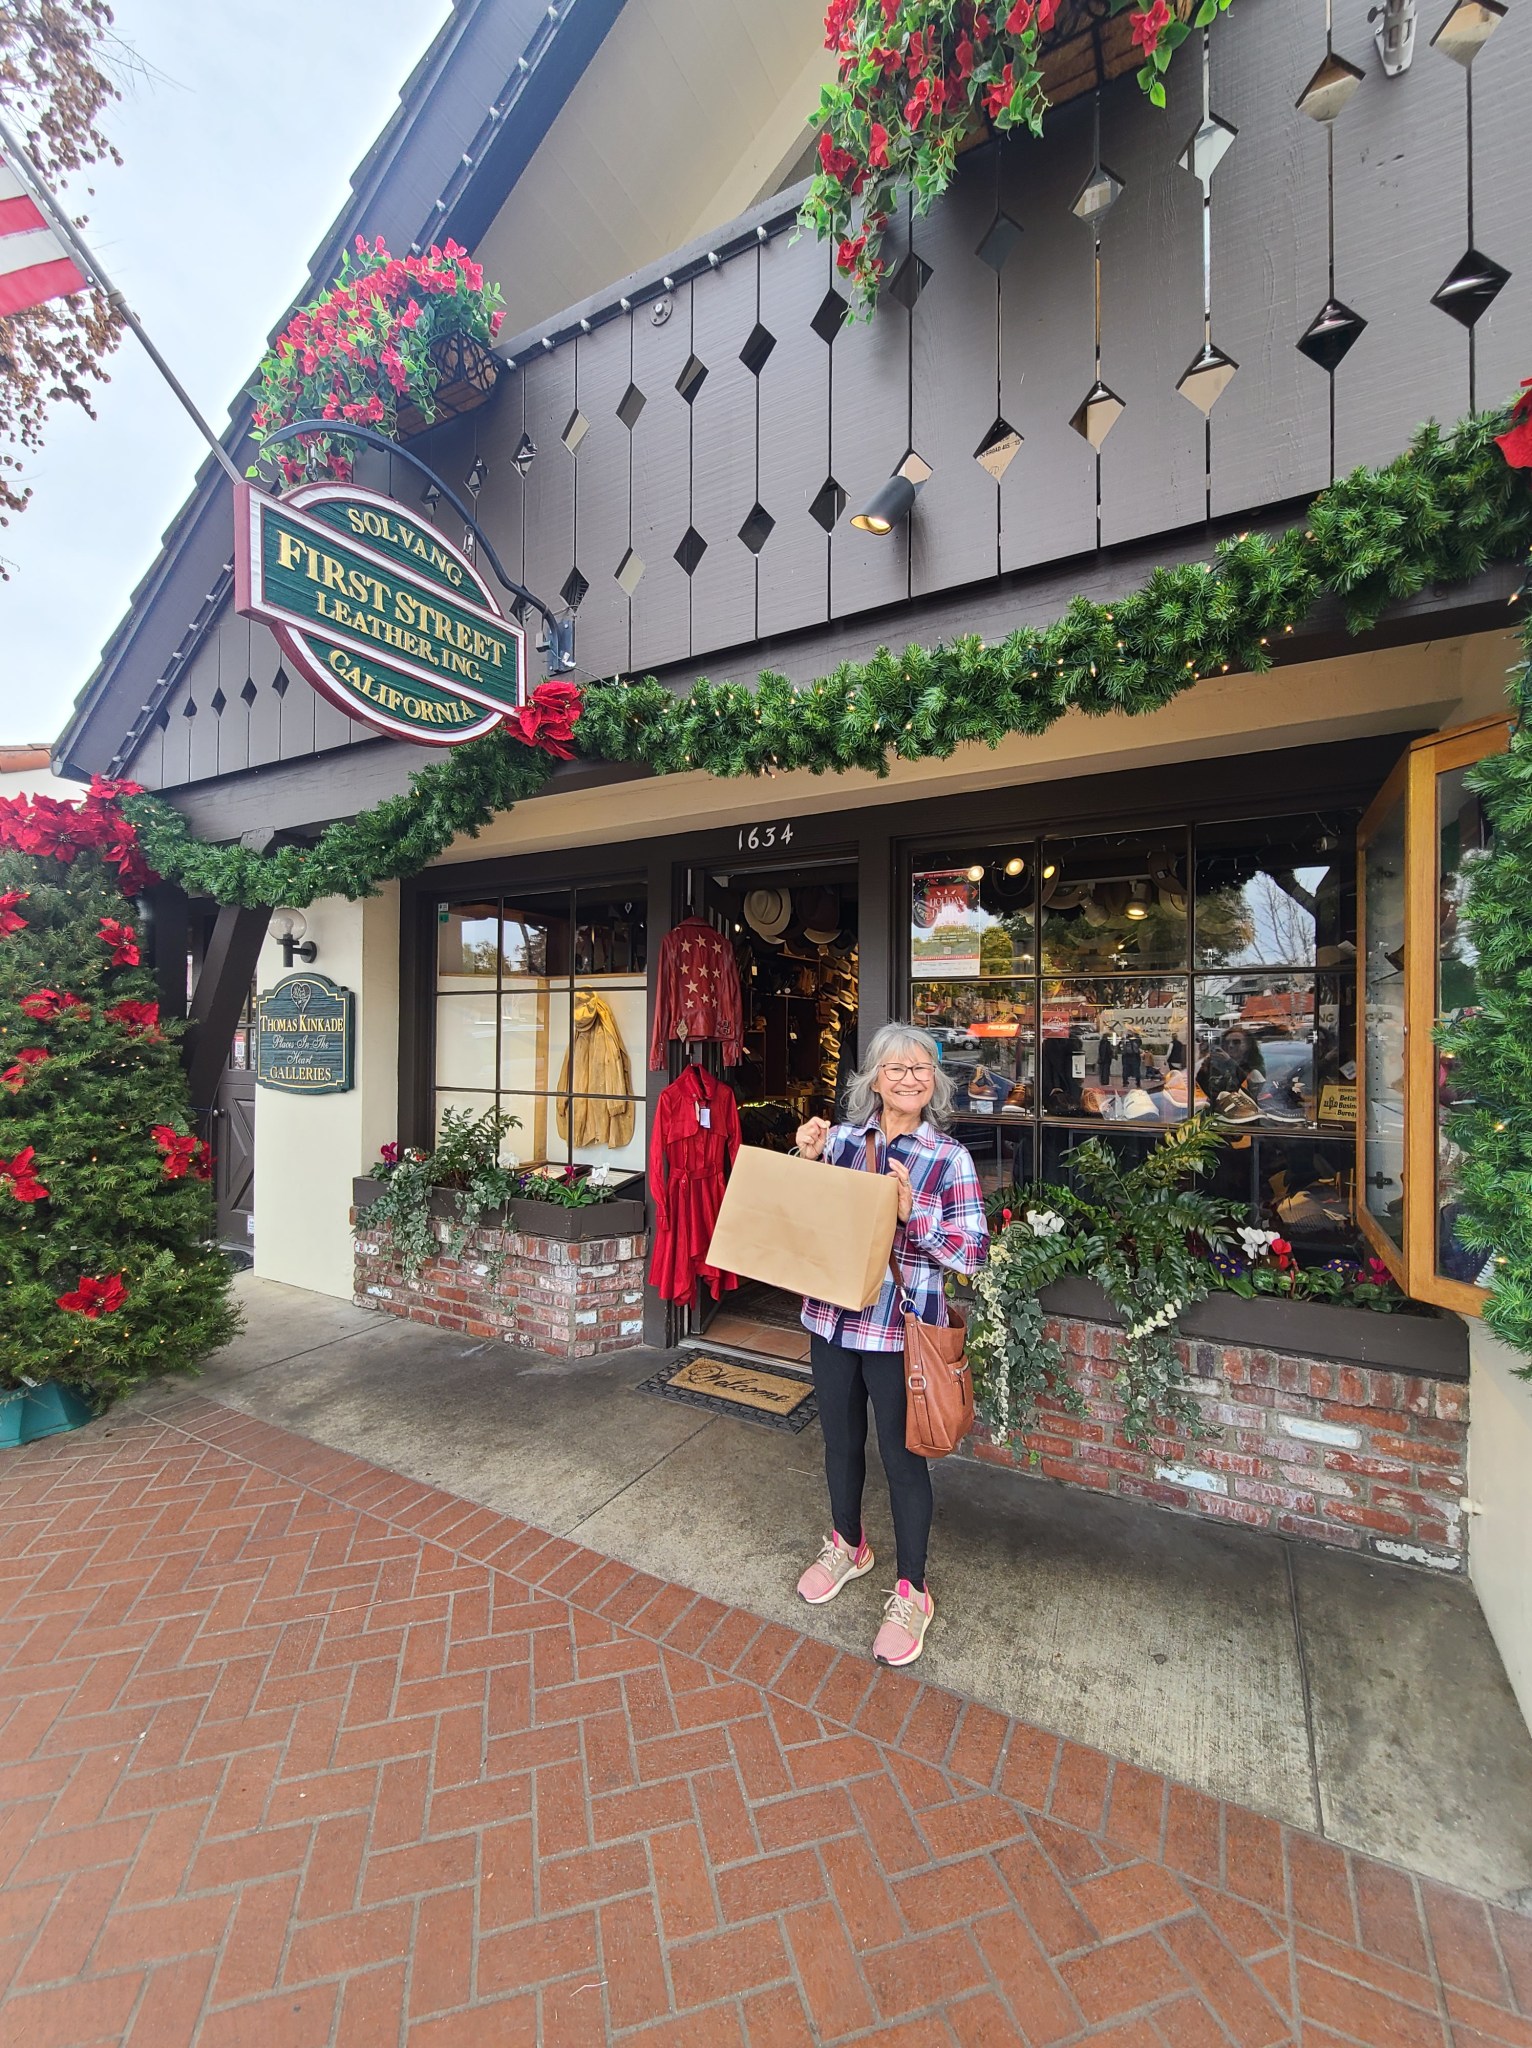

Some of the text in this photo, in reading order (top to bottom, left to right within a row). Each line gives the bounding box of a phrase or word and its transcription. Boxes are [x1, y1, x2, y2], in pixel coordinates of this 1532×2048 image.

[347, 508, 463, 586] SOLVANG
[276, 529, 507, 668] FIRST STREET
[316, 590, 484, 684] LEATHER, INC.
[328, 649, 477, 724] CALIFORNIA
[738, 823, 794, 852] 1634
[269, 1066, 332, 1081] GALLERIES
[286, 1050, 313, 1064] Heart
[687, 1364, 791, 1403] Welcome
